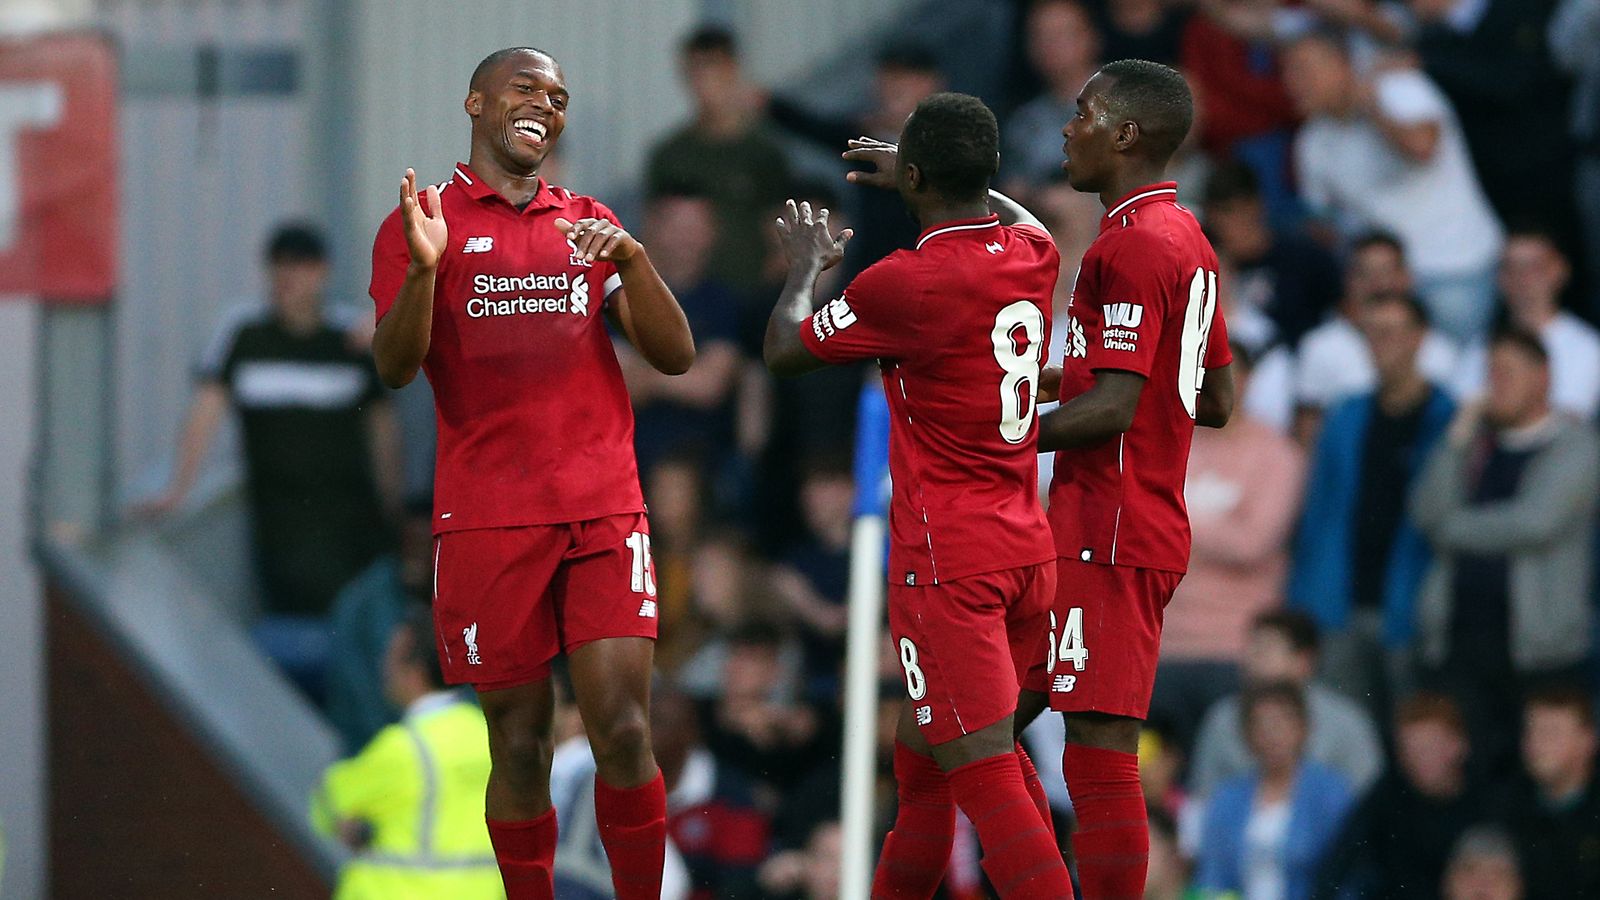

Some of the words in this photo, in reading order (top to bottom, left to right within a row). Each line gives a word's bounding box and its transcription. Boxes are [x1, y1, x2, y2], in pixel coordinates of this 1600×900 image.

[474, 273, 568, 294] Standard
[467, 295, 567, 318] Chartered
[1102, 302, 1144, 328] WU
[1104, 338, 1136, 352] Union
[991, 300, 1044, 444] 8
[900, 637, 927, 701] 8
